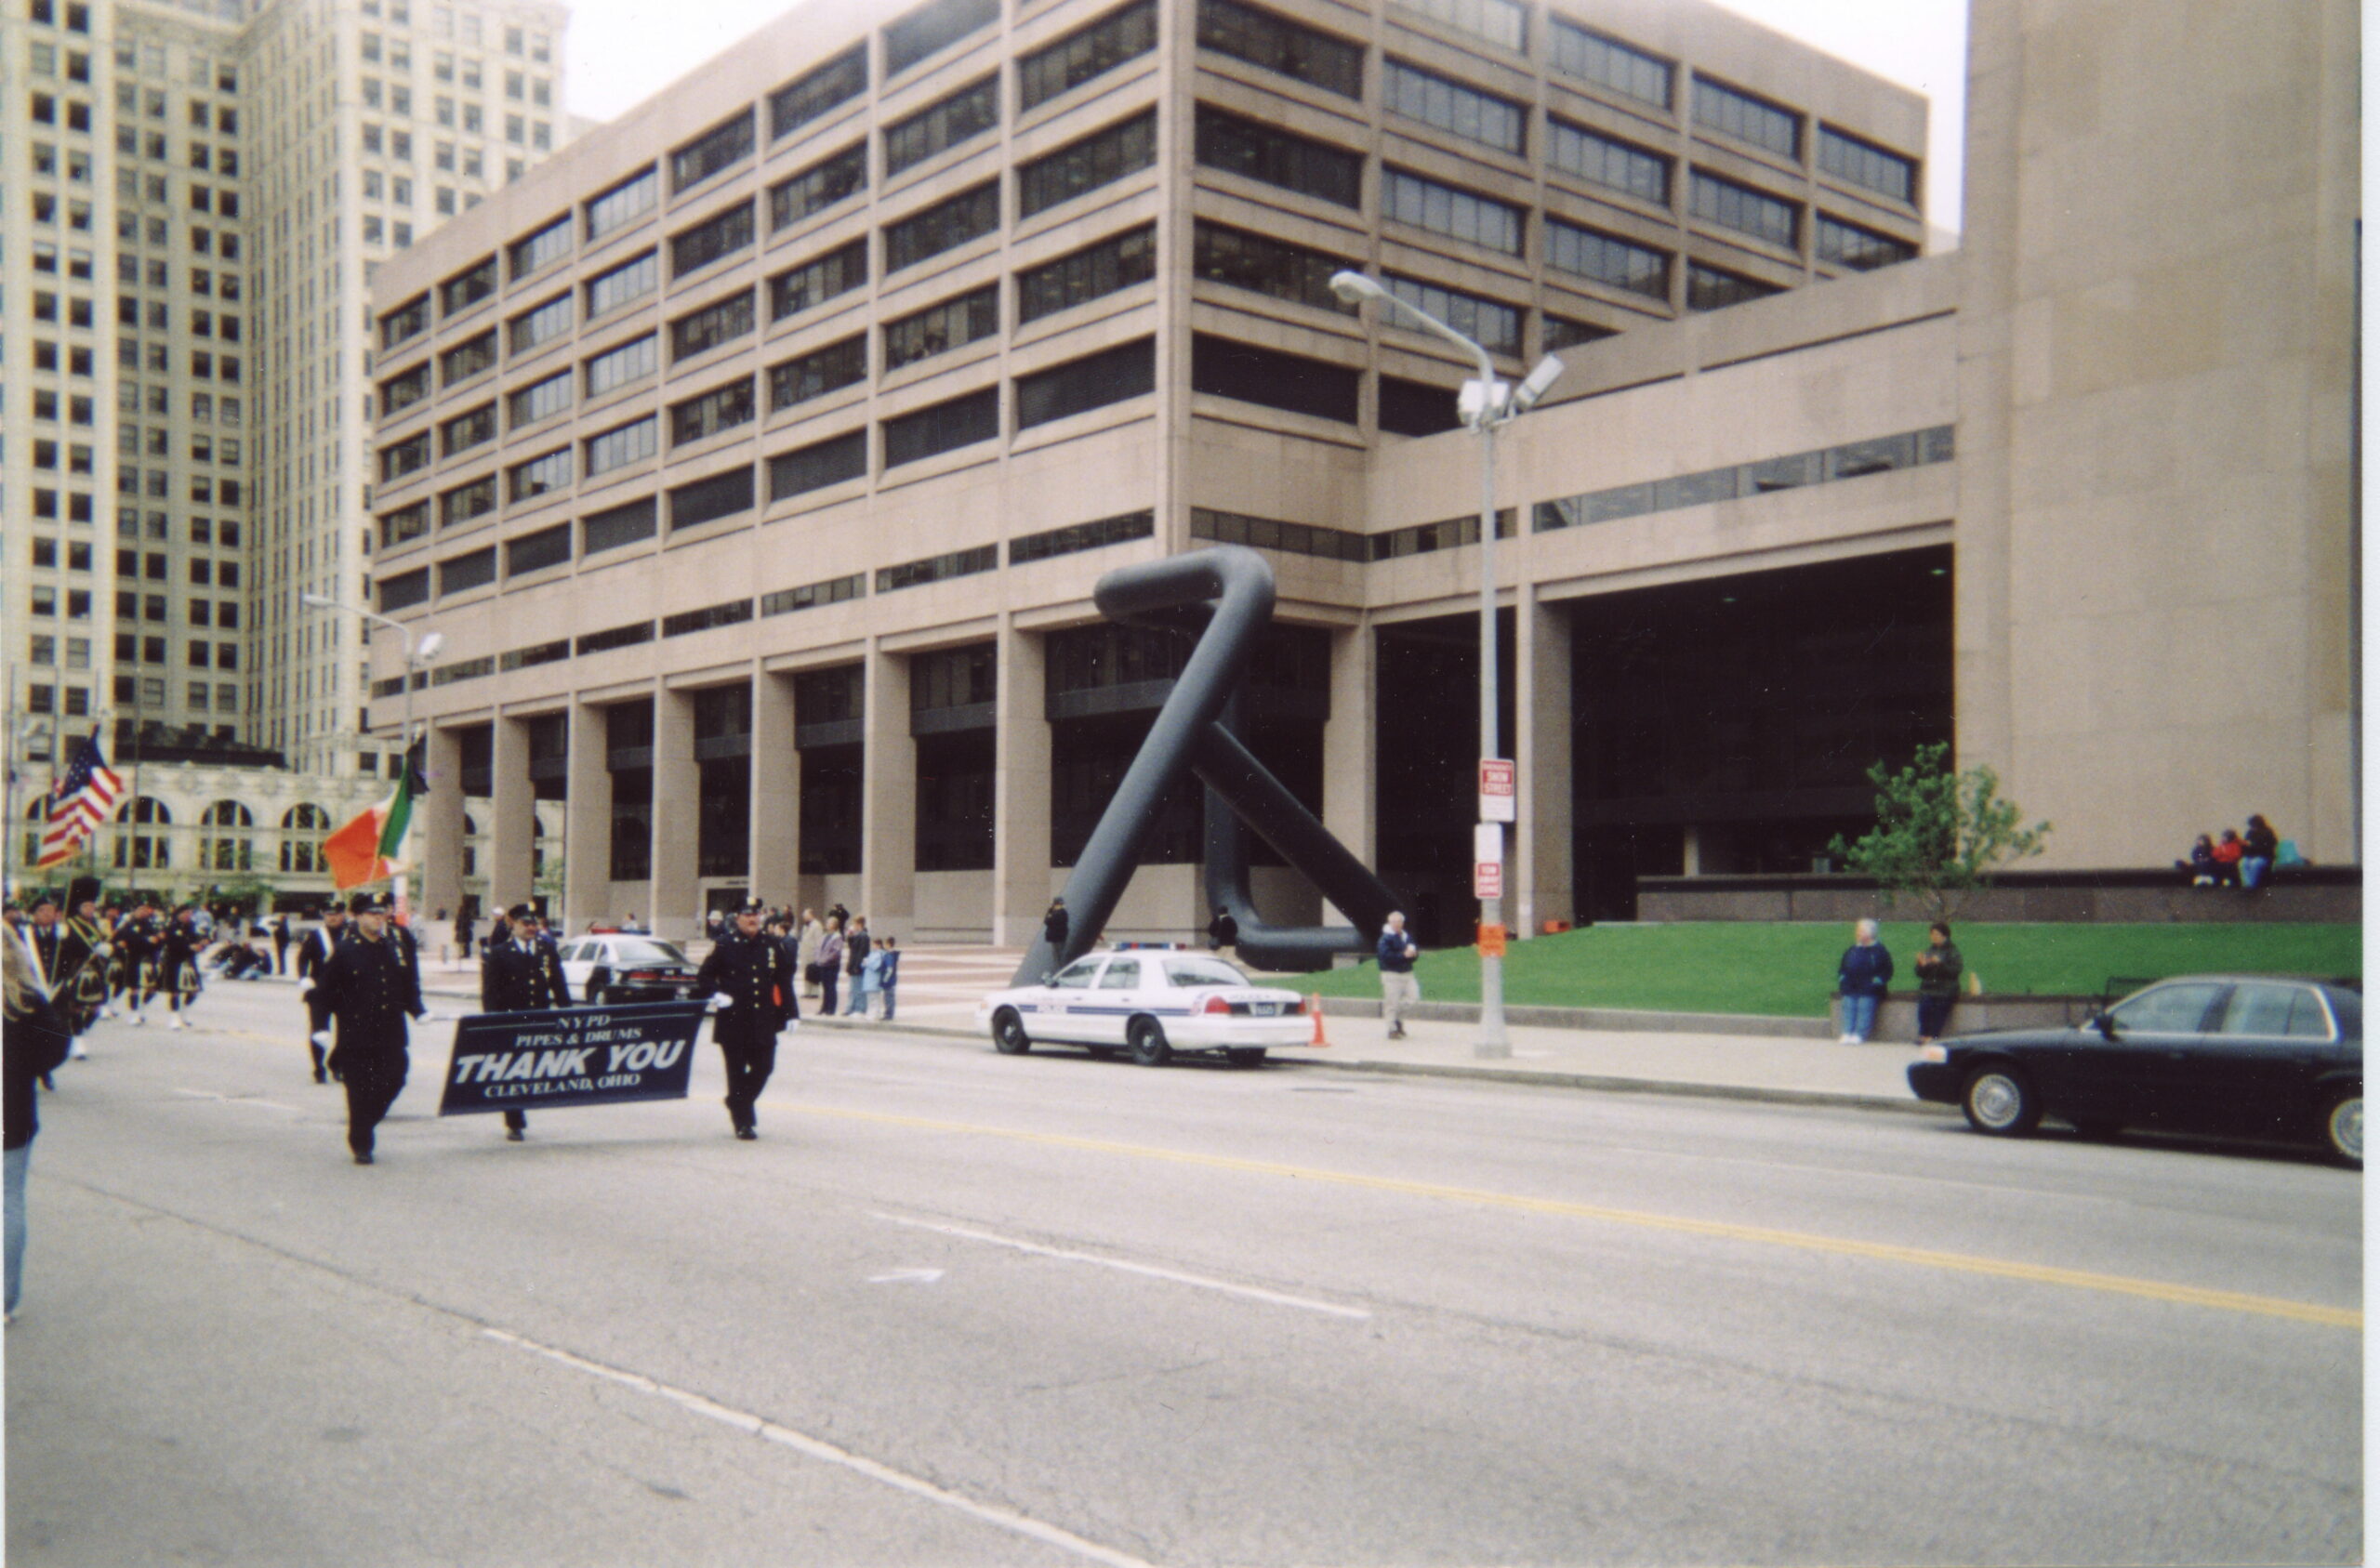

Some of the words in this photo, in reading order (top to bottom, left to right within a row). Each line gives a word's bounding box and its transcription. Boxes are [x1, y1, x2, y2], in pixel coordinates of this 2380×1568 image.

[558, 1015, 610, 1029] NYPD
[515, 1034, 562, 1047] PIPES
[566, 1032, 578, 1045] &
[585, 1028, 641, 1042] DRUMS
[455, 1048, 596, 1084] THANK
[607, 1040, 686, 1072] YOU
[484, 1077, 594, 1098] CLEVELAND,
[598, 1074, 640, 1088] OHIO
